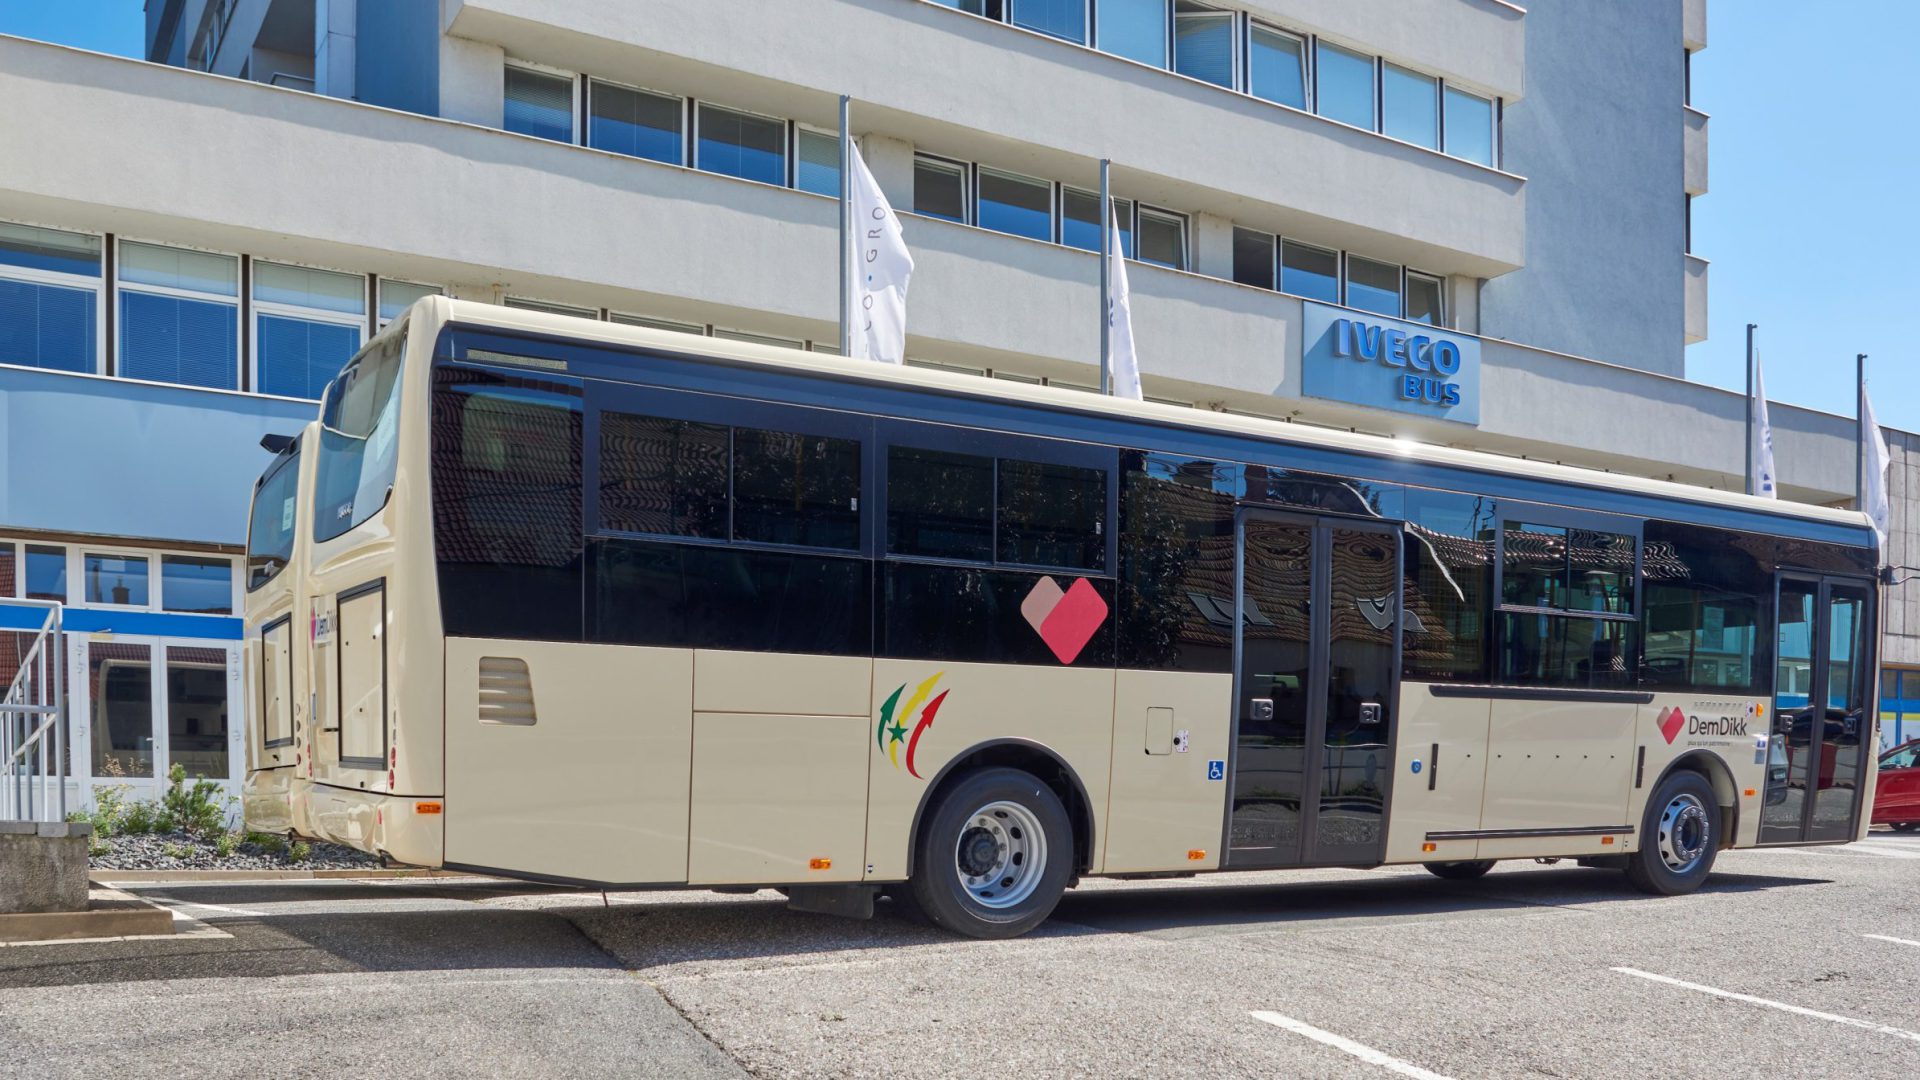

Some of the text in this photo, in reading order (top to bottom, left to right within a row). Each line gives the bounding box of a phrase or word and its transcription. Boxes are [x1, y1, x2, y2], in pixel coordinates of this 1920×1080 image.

[866, 207, 887, 264] GRO
[1334, 319, 1461, 376] IVECO
[1401, 374, 1461, 407] BUS
[1688, 715, 1747, 736] DemDikk
